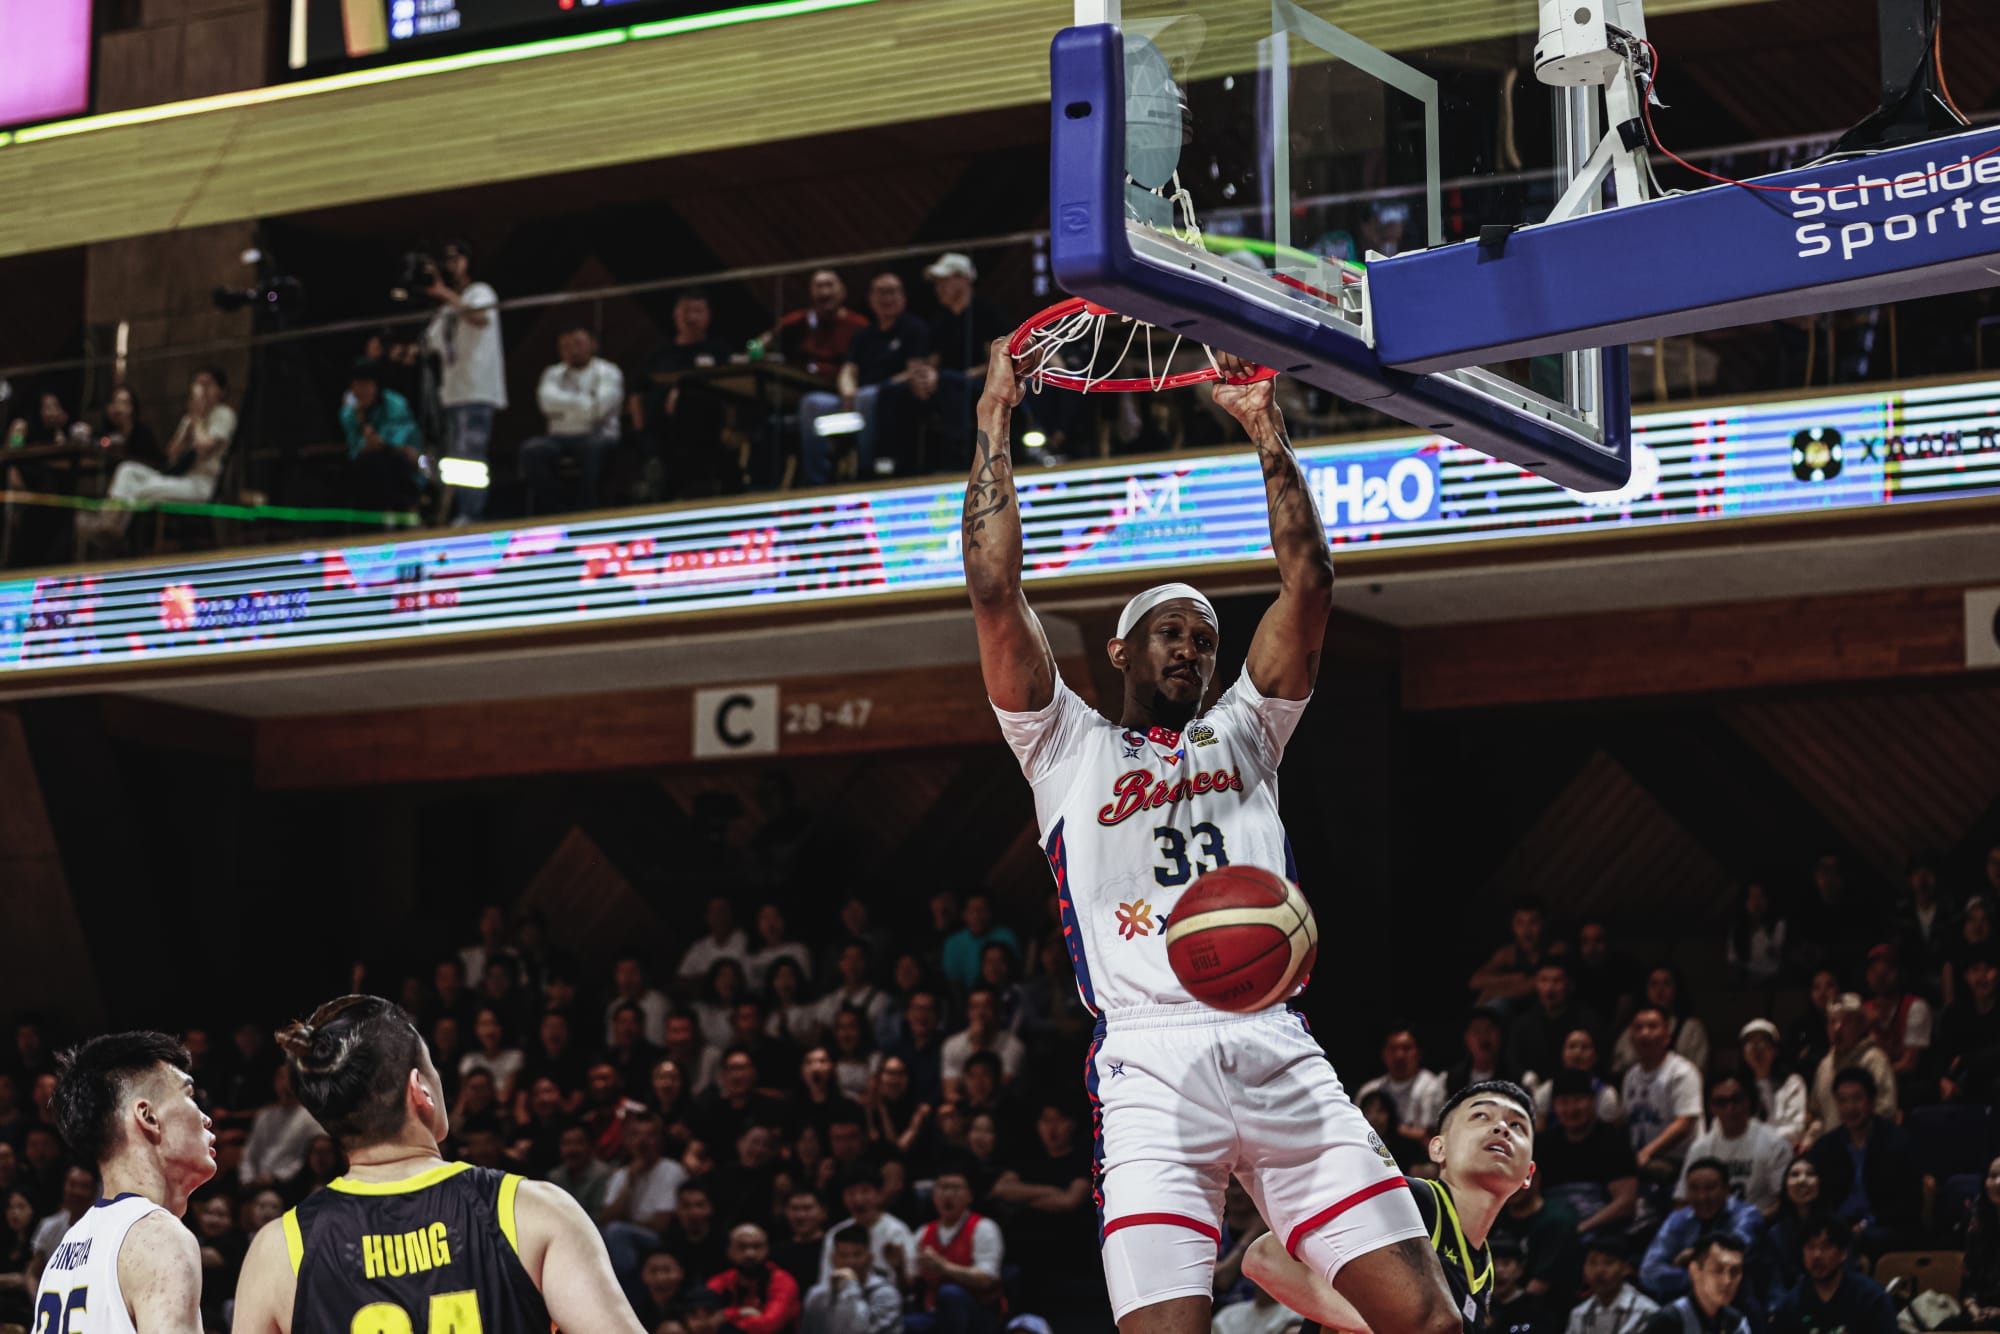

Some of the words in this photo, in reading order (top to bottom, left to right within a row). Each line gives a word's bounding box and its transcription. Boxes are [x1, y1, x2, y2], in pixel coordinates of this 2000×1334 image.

[1790, 155, 2000, 219] Schelde
[1795, 195, 2000, 260] Sports
[714, 694, 755, 748] C
[1154, 822, 1230, 887] 33
[361, 1221, 451, 1280] HUNG
